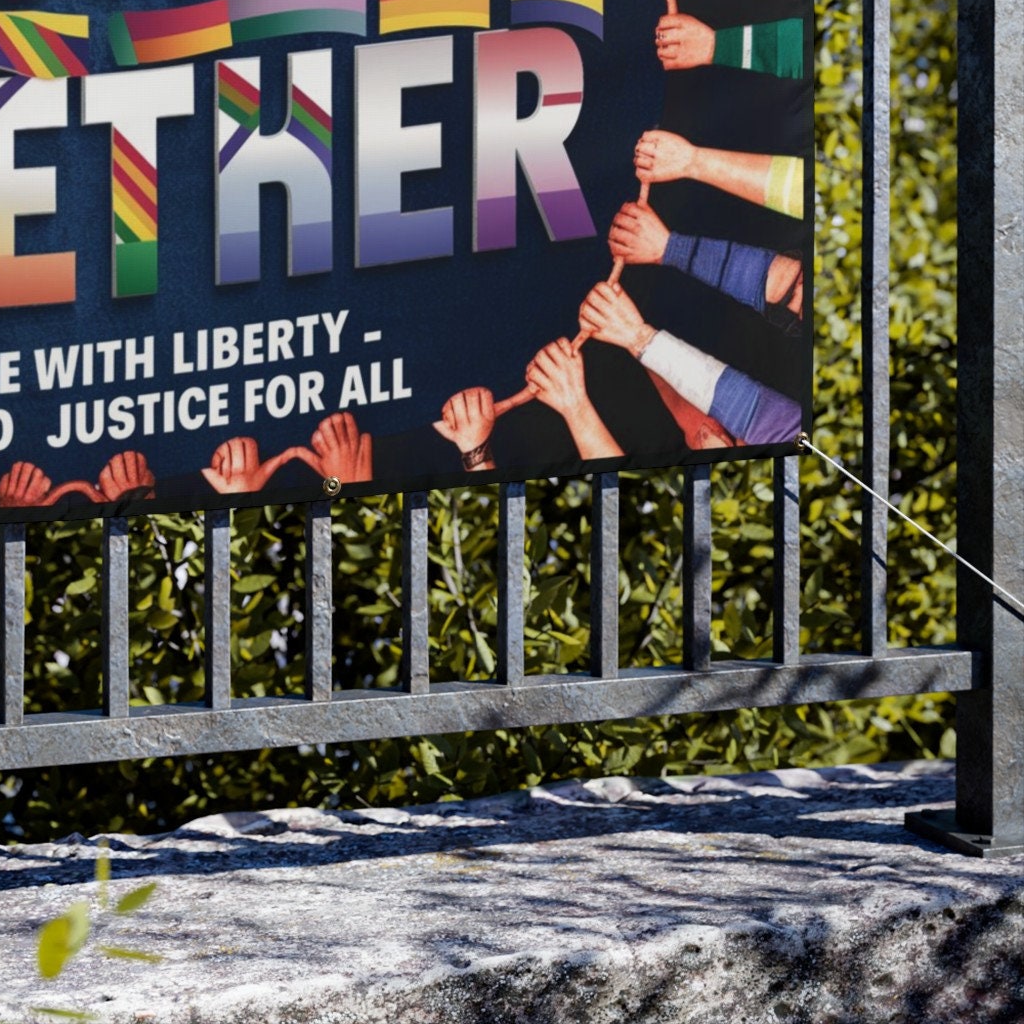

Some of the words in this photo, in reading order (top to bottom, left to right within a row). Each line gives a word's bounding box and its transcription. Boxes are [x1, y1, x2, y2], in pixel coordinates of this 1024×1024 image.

[33, 336, 155, 391] WITH
[173, 310, 349, 375] LIBERTY
[46, 383, 230, 448] JUSTICE
[244, 374, 325, 423] FOR
[338, 357, 412, 409] ALL
